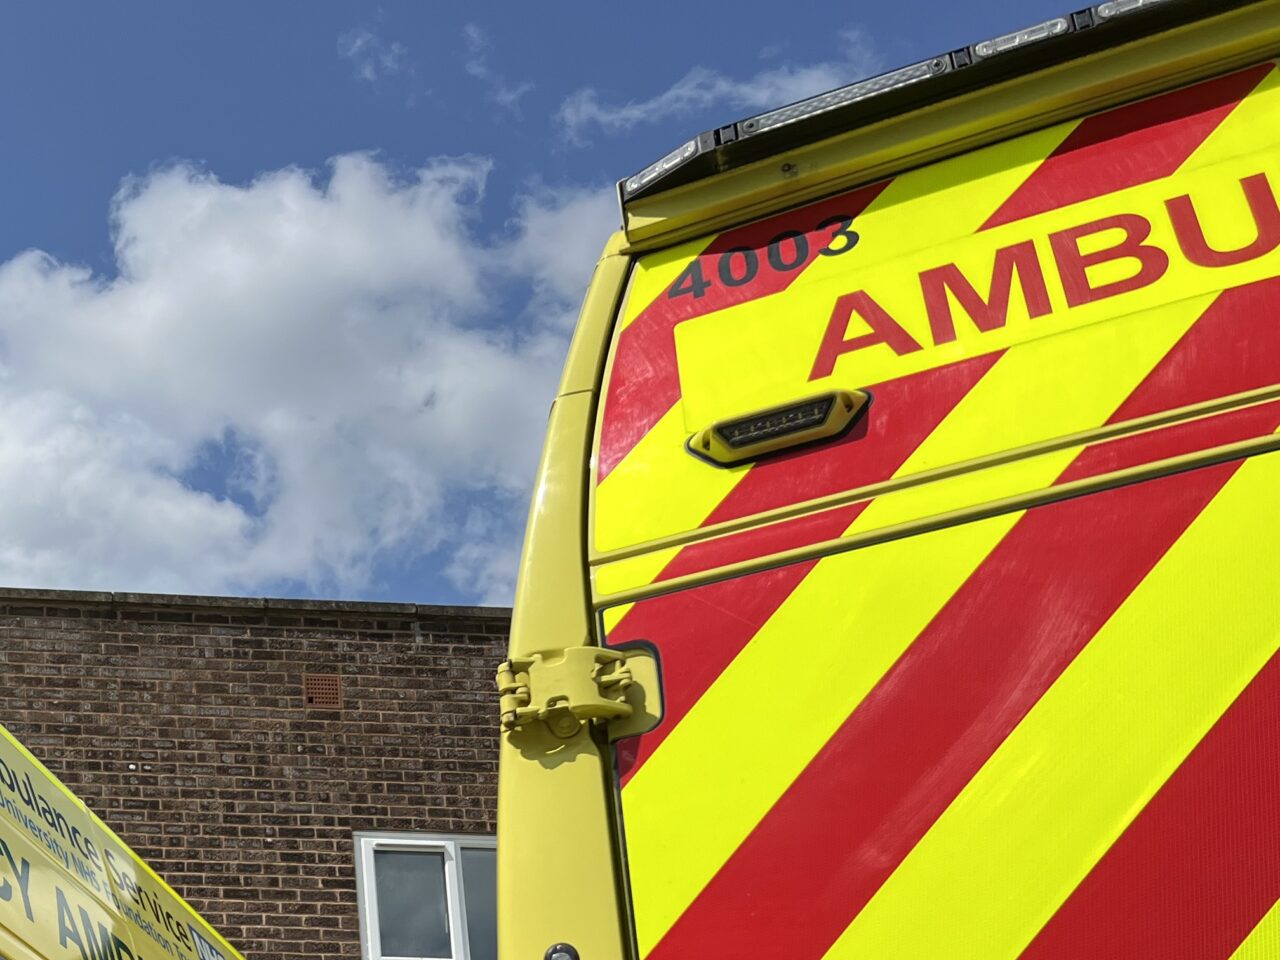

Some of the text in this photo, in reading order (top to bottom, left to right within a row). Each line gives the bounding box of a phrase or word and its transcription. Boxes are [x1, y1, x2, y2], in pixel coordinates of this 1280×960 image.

[667, 214, 861, 300] 4003
[807, 172, 1280, 383] AMBU
[70, 852, 101, 893] NHS
[102, 879, 175, 956] Foundation
[104, 848, 193, 952] Service
